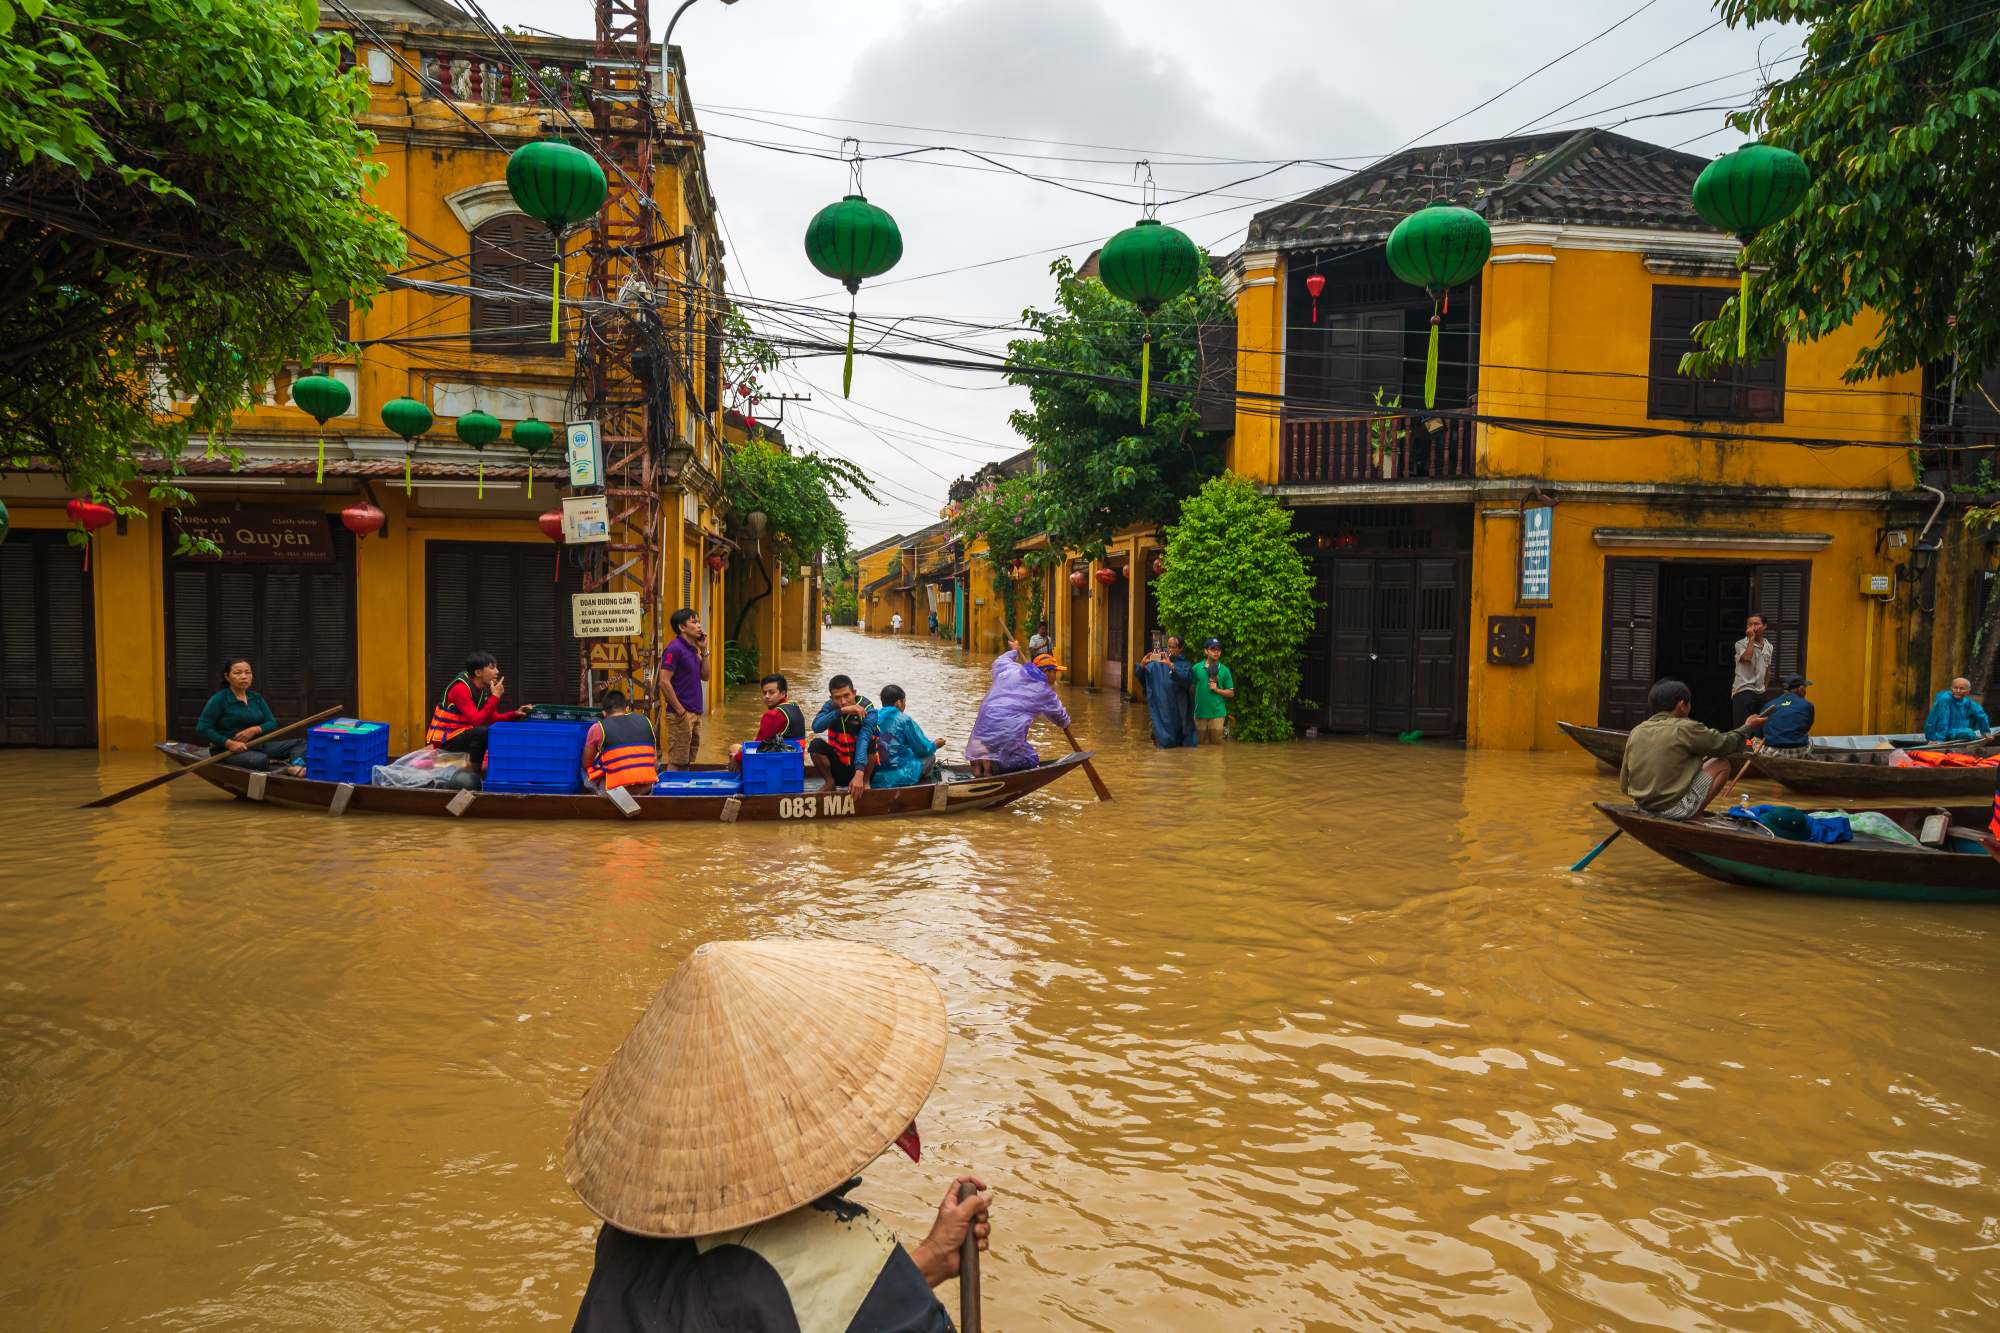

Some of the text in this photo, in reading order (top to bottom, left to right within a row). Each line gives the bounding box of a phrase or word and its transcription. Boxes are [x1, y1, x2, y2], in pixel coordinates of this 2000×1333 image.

[236, 528, 310, 548] Quyên
[591, 643, 639, 661] ATM
[780, 794, 856, 819] 083 MA
